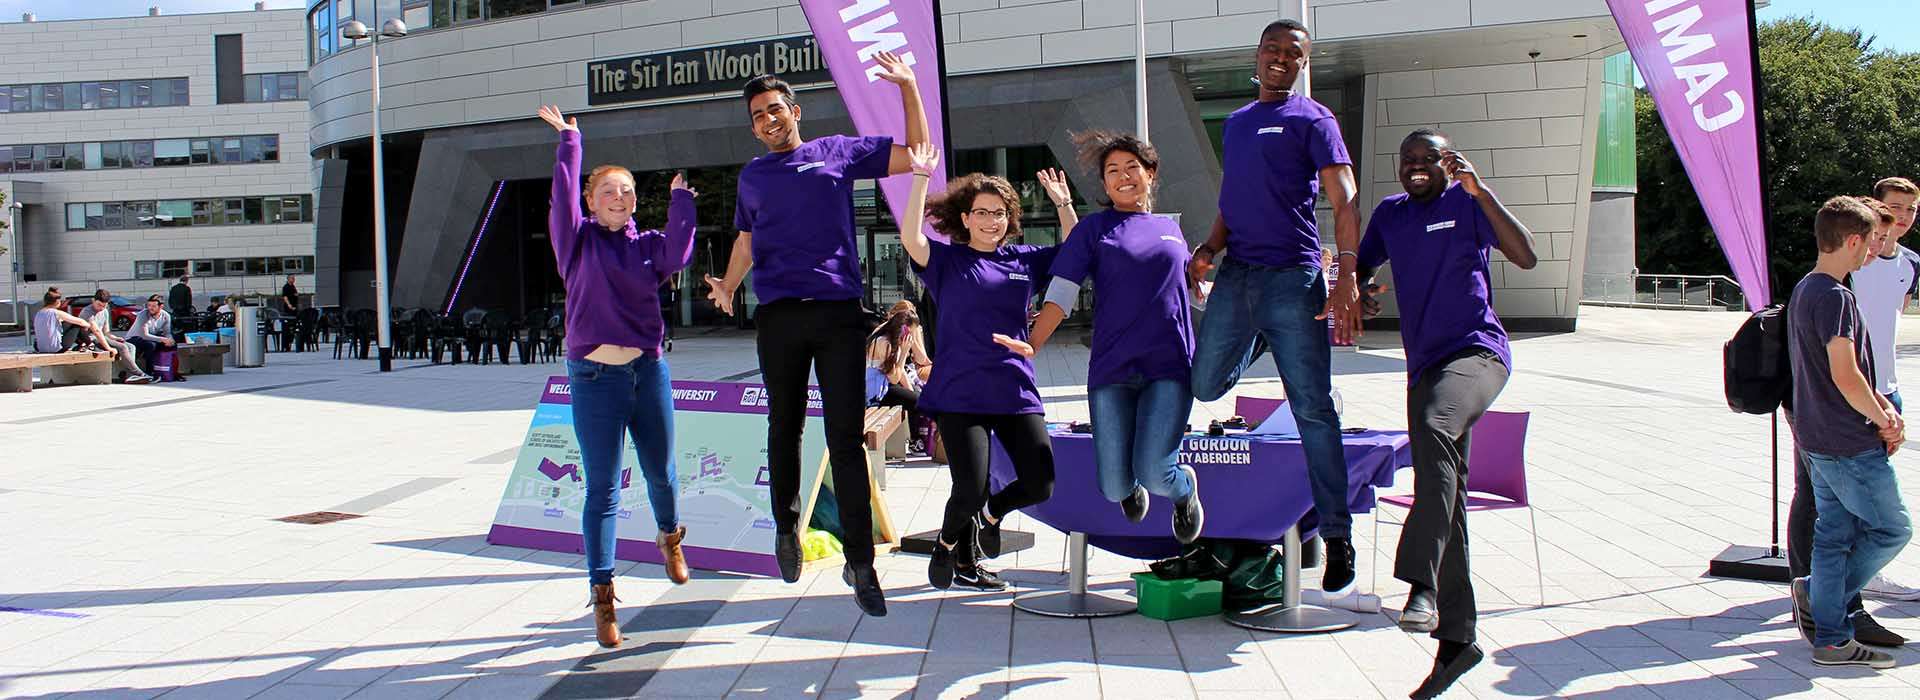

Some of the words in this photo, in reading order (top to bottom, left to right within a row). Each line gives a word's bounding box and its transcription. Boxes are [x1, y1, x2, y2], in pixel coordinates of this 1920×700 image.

[590, 63, 626, 93] The
[631, 58, 660, 90] Sir
[666, 55, 699, 86] Ian
[704, 44, 765, 80] Wood
[549, 384, 571, 395] WELC
[671, 389, 718, 401] NIVERSITY
[1189, 438, 1250, 451] GORDON
[1195, 453, 1251, 464] ABERDEEN
